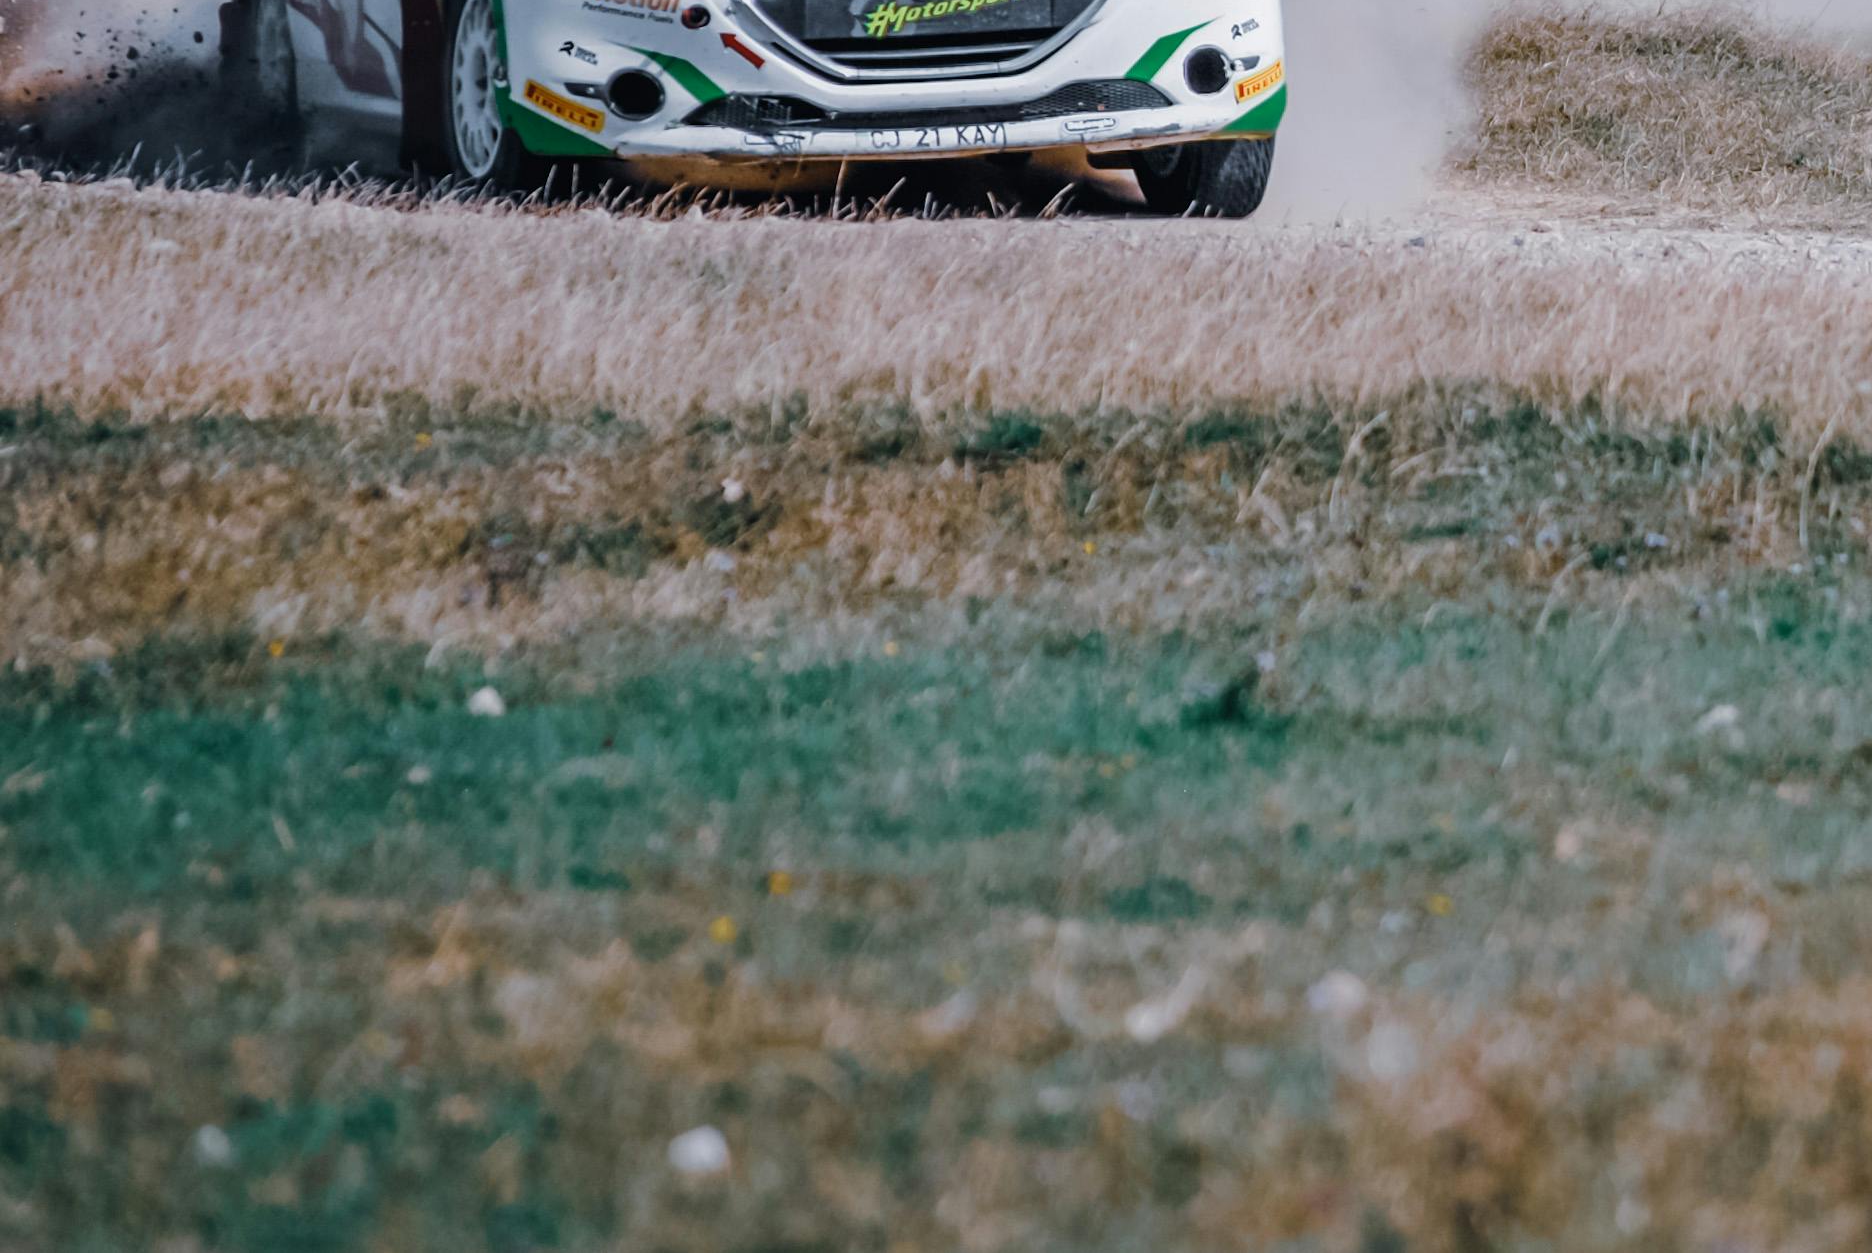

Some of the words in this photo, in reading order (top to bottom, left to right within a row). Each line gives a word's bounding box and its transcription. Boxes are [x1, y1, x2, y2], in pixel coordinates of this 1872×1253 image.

[1238, 61, 1282, 99] PIRELLI
[526, 82, 600, 128] PIRELLI
[870, 130, 900, 148] CJ
[915, 127, 940, 147] 21
[956, 123, 1000, 146] KAY
